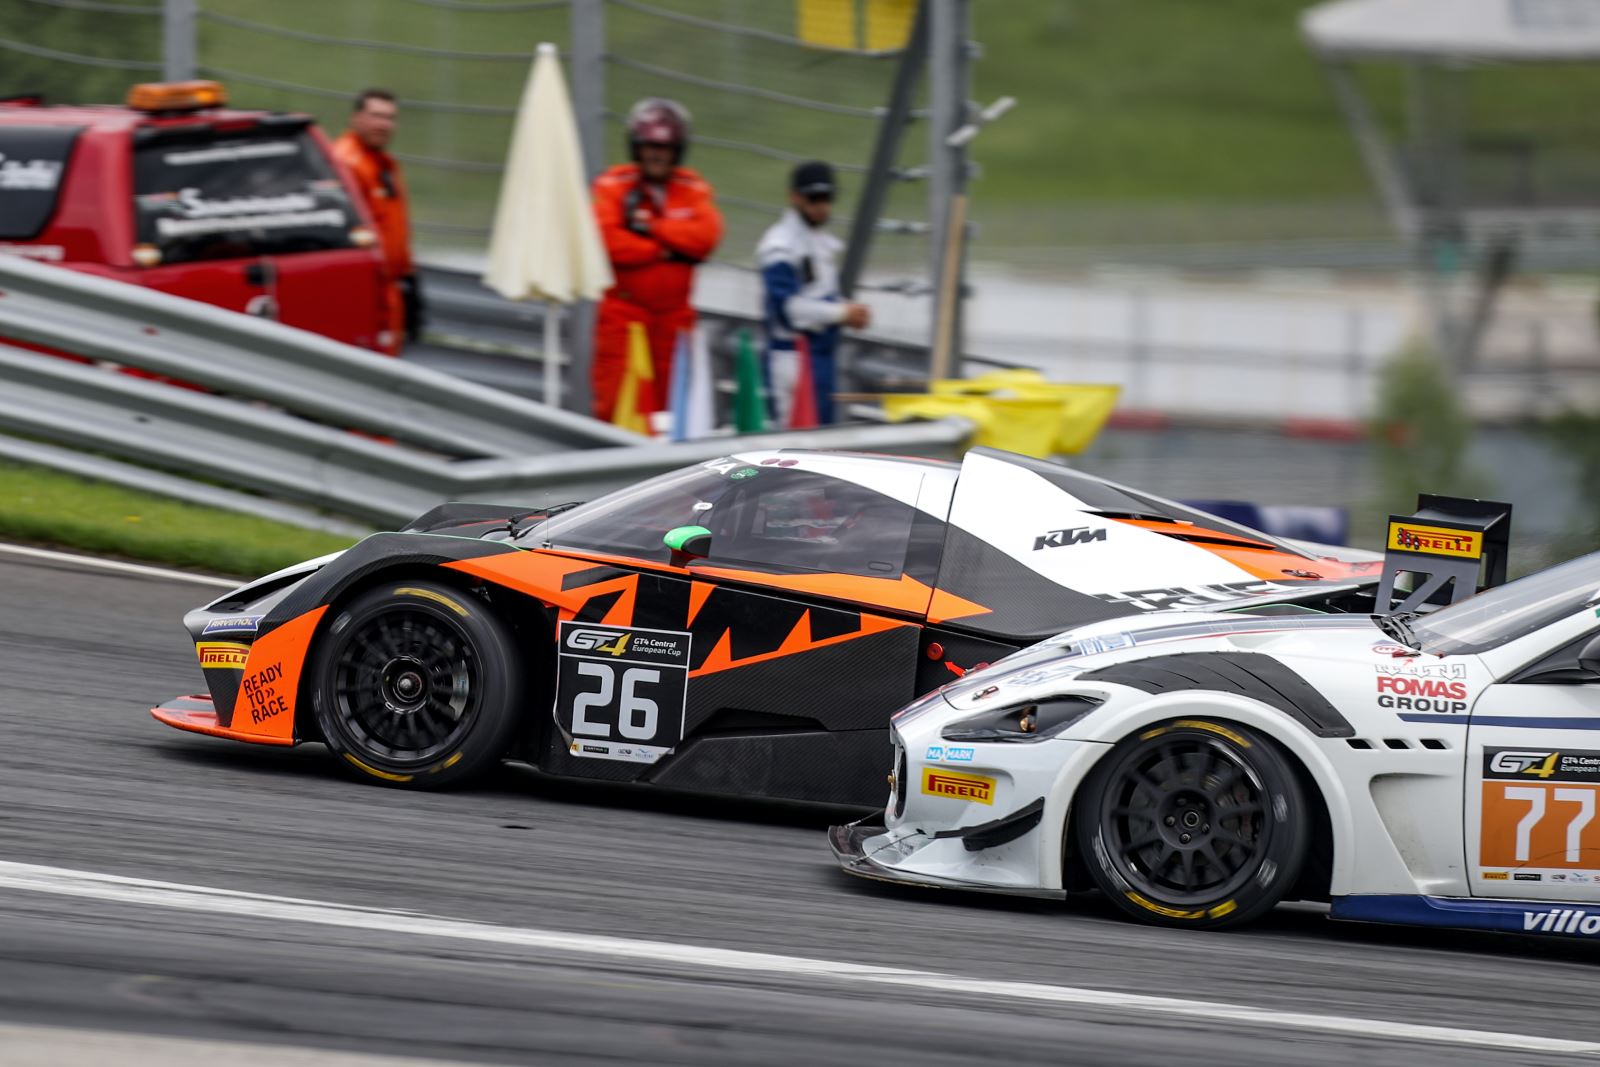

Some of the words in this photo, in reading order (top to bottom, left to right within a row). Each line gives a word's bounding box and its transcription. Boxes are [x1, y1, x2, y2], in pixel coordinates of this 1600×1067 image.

[1032, 526, 1108, 551] KTM
[1398, 528, 1473, 553] PIRELLI
[200, 647, 250, 663] PIRELLI
[566, 628, 632, 657] GT4
[632, 644, 667, 655] European
[667, 648, 682, 657] Cup
[633, 637, 650, 646] GT4
[650, 639, 677, 648] Central
[243, 661, 283, 695] READY
[1377, 676, 1467, 700] FOMAS
[247, 689, 265, 709] TO
[251, 695, 289, 725] RACE
[571, 661, 661, 740] 26
[1377, 695, 1467, 714] GROUP
[1490, 751, 1560, 778] GT4
[1560, 764, 1598, 773] European
[1561, 756, 1579, 764] GT4
[927, 774, 990, 800] PIRELLI
[1504, 786, 1597, 863] 77
[1523, 908, 1600, 935] villo
